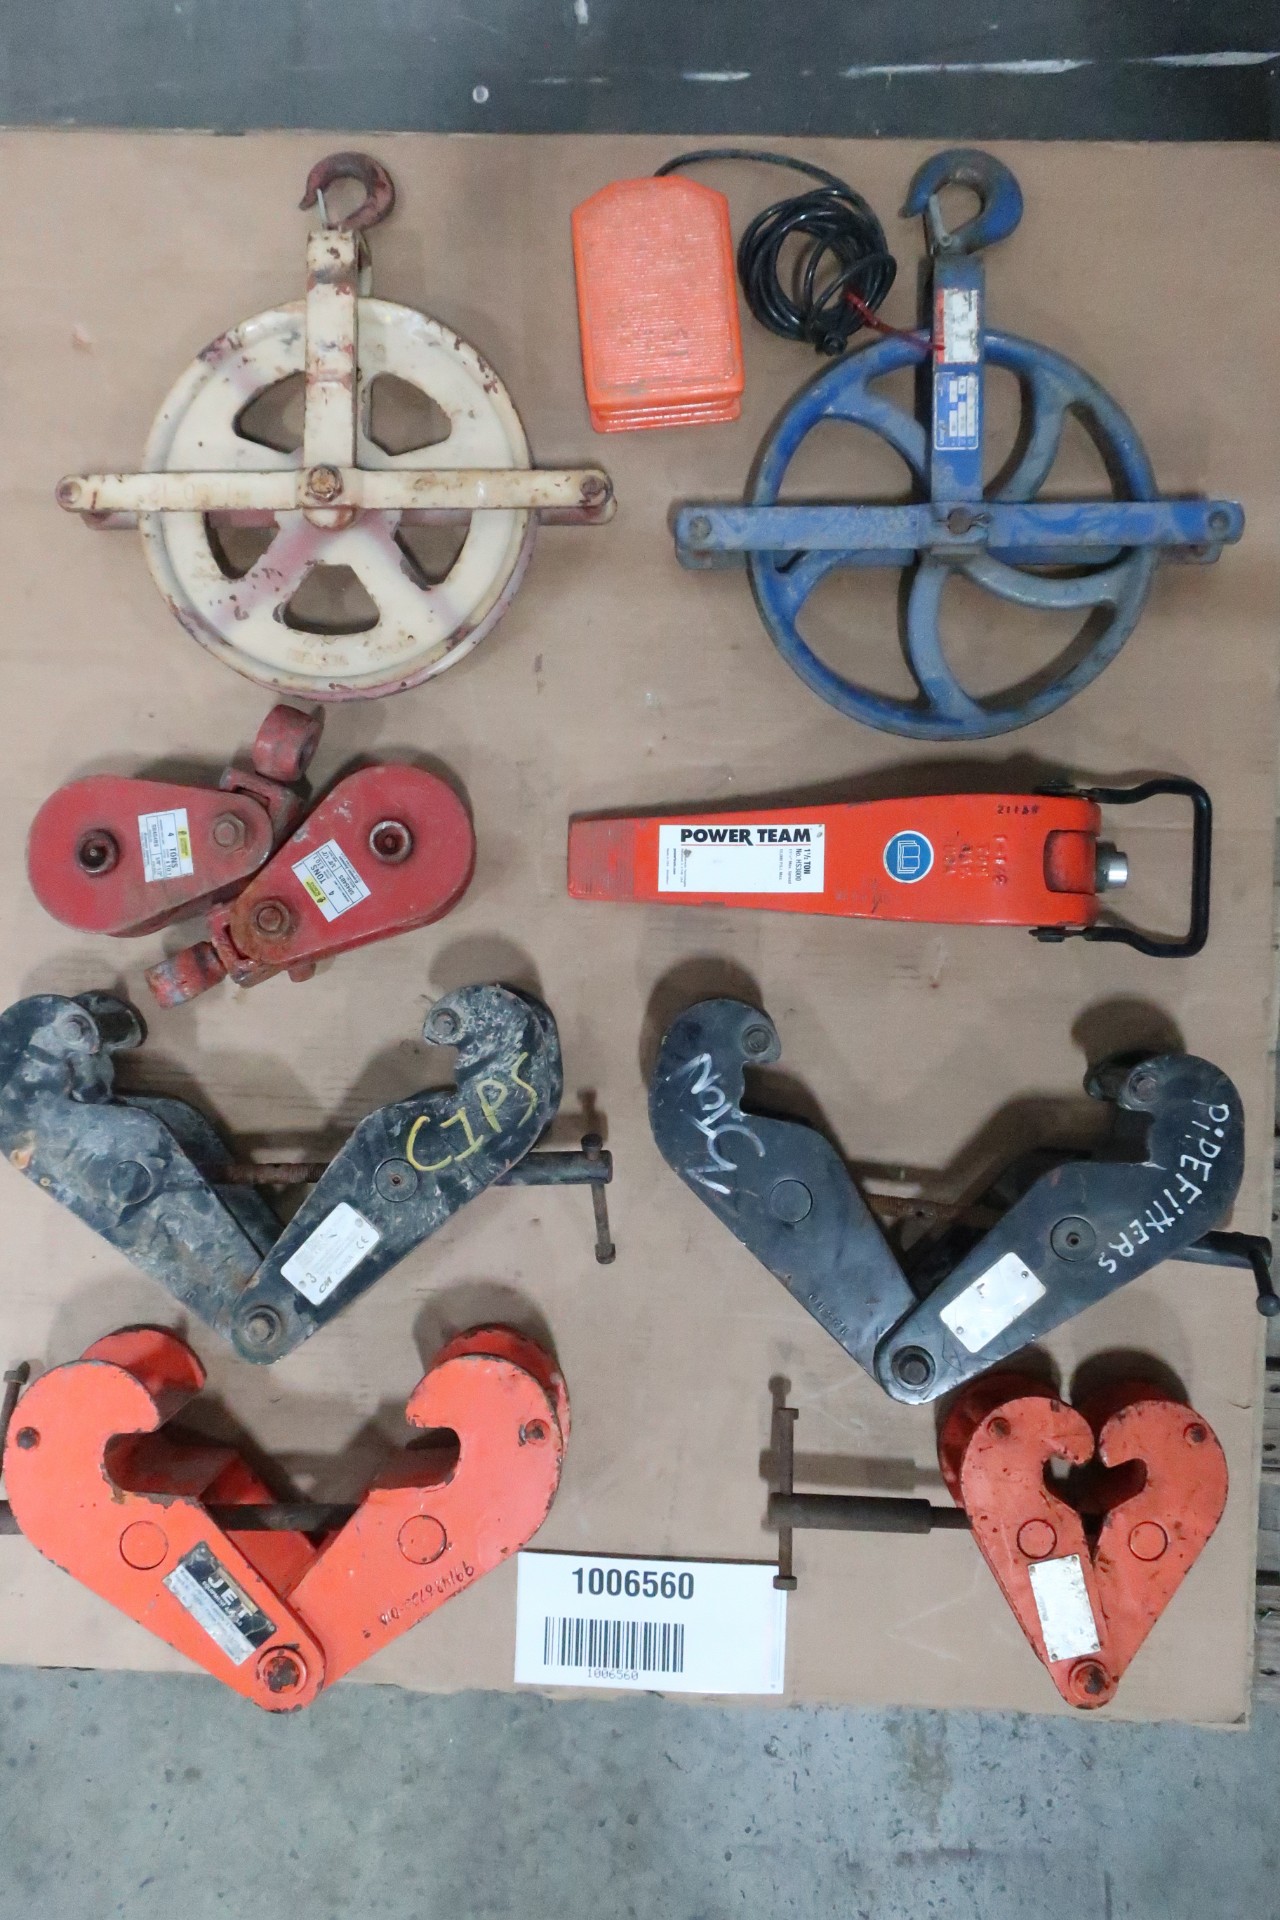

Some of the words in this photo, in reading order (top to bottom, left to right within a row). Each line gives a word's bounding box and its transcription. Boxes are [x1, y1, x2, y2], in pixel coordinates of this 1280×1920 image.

[680, 828, 753, 846] POWER
[757, 828, 811, 843] TEAM
[169, 848, 178, 868] TONS
[310, 864, 327, 884] TONS
[571, 1567, 695, 1600] 1006560
[207, 1576, 254, 1619] JET
[586, 1668, 639, 1681] 1006560
